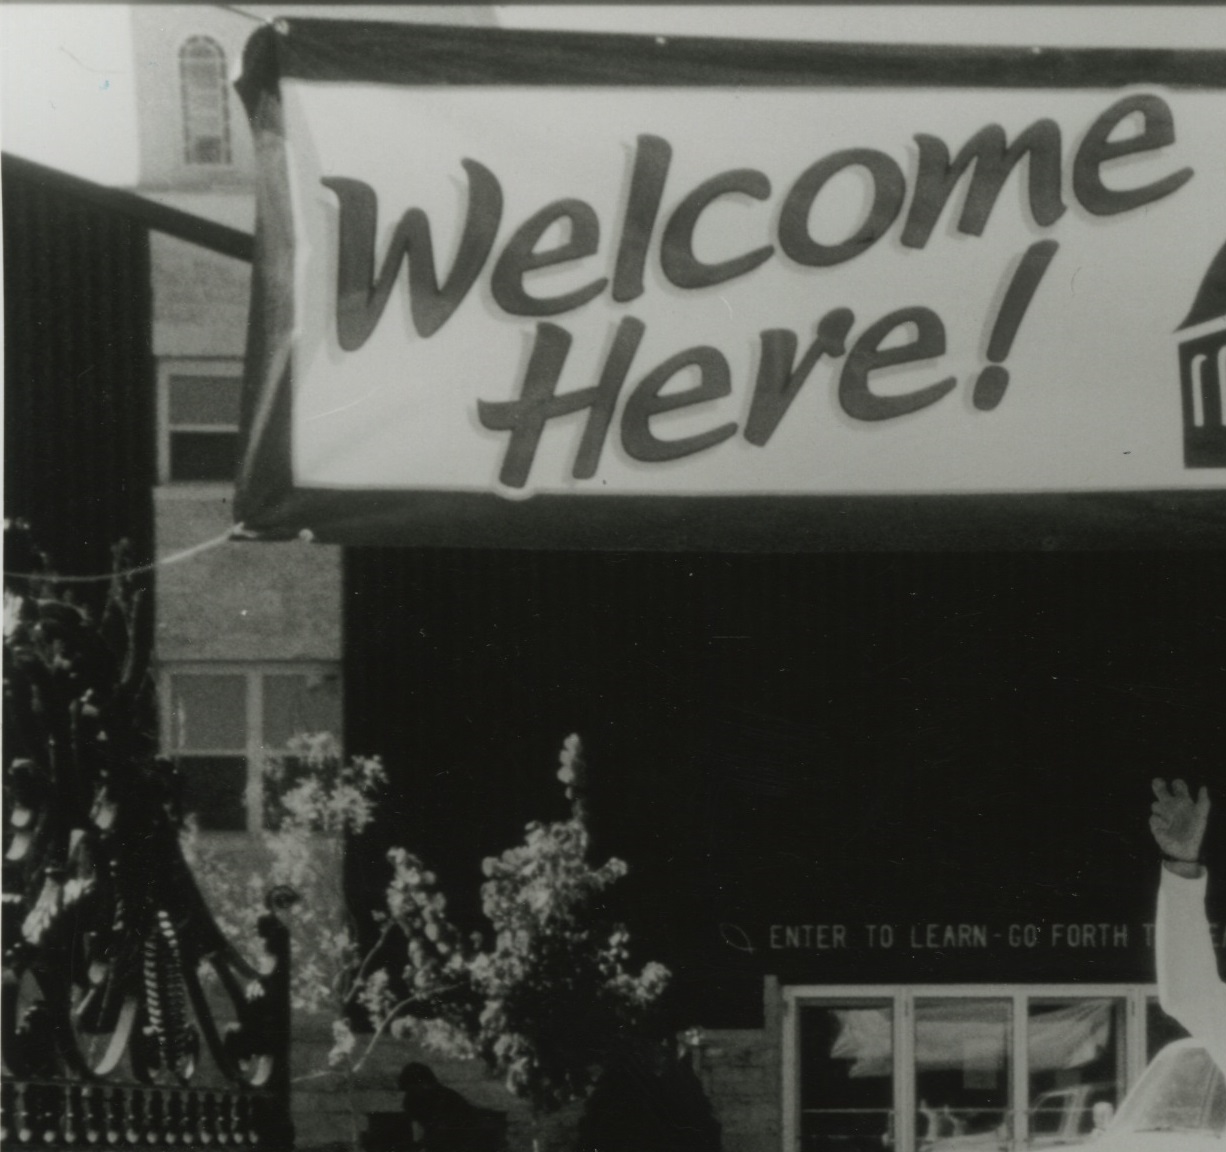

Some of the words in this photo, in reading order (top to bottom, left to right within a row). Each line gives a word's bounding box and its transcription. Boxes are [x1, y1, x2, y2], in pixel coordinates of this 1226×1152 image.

[320, 93, 1195, 352] Welcome
[476, 239, 1060, 489] Here!
[769, 924, 848, 949] ENTER
[865, 924, 894, 948] TO
[1051, 923, 1128, 948] FORTH
